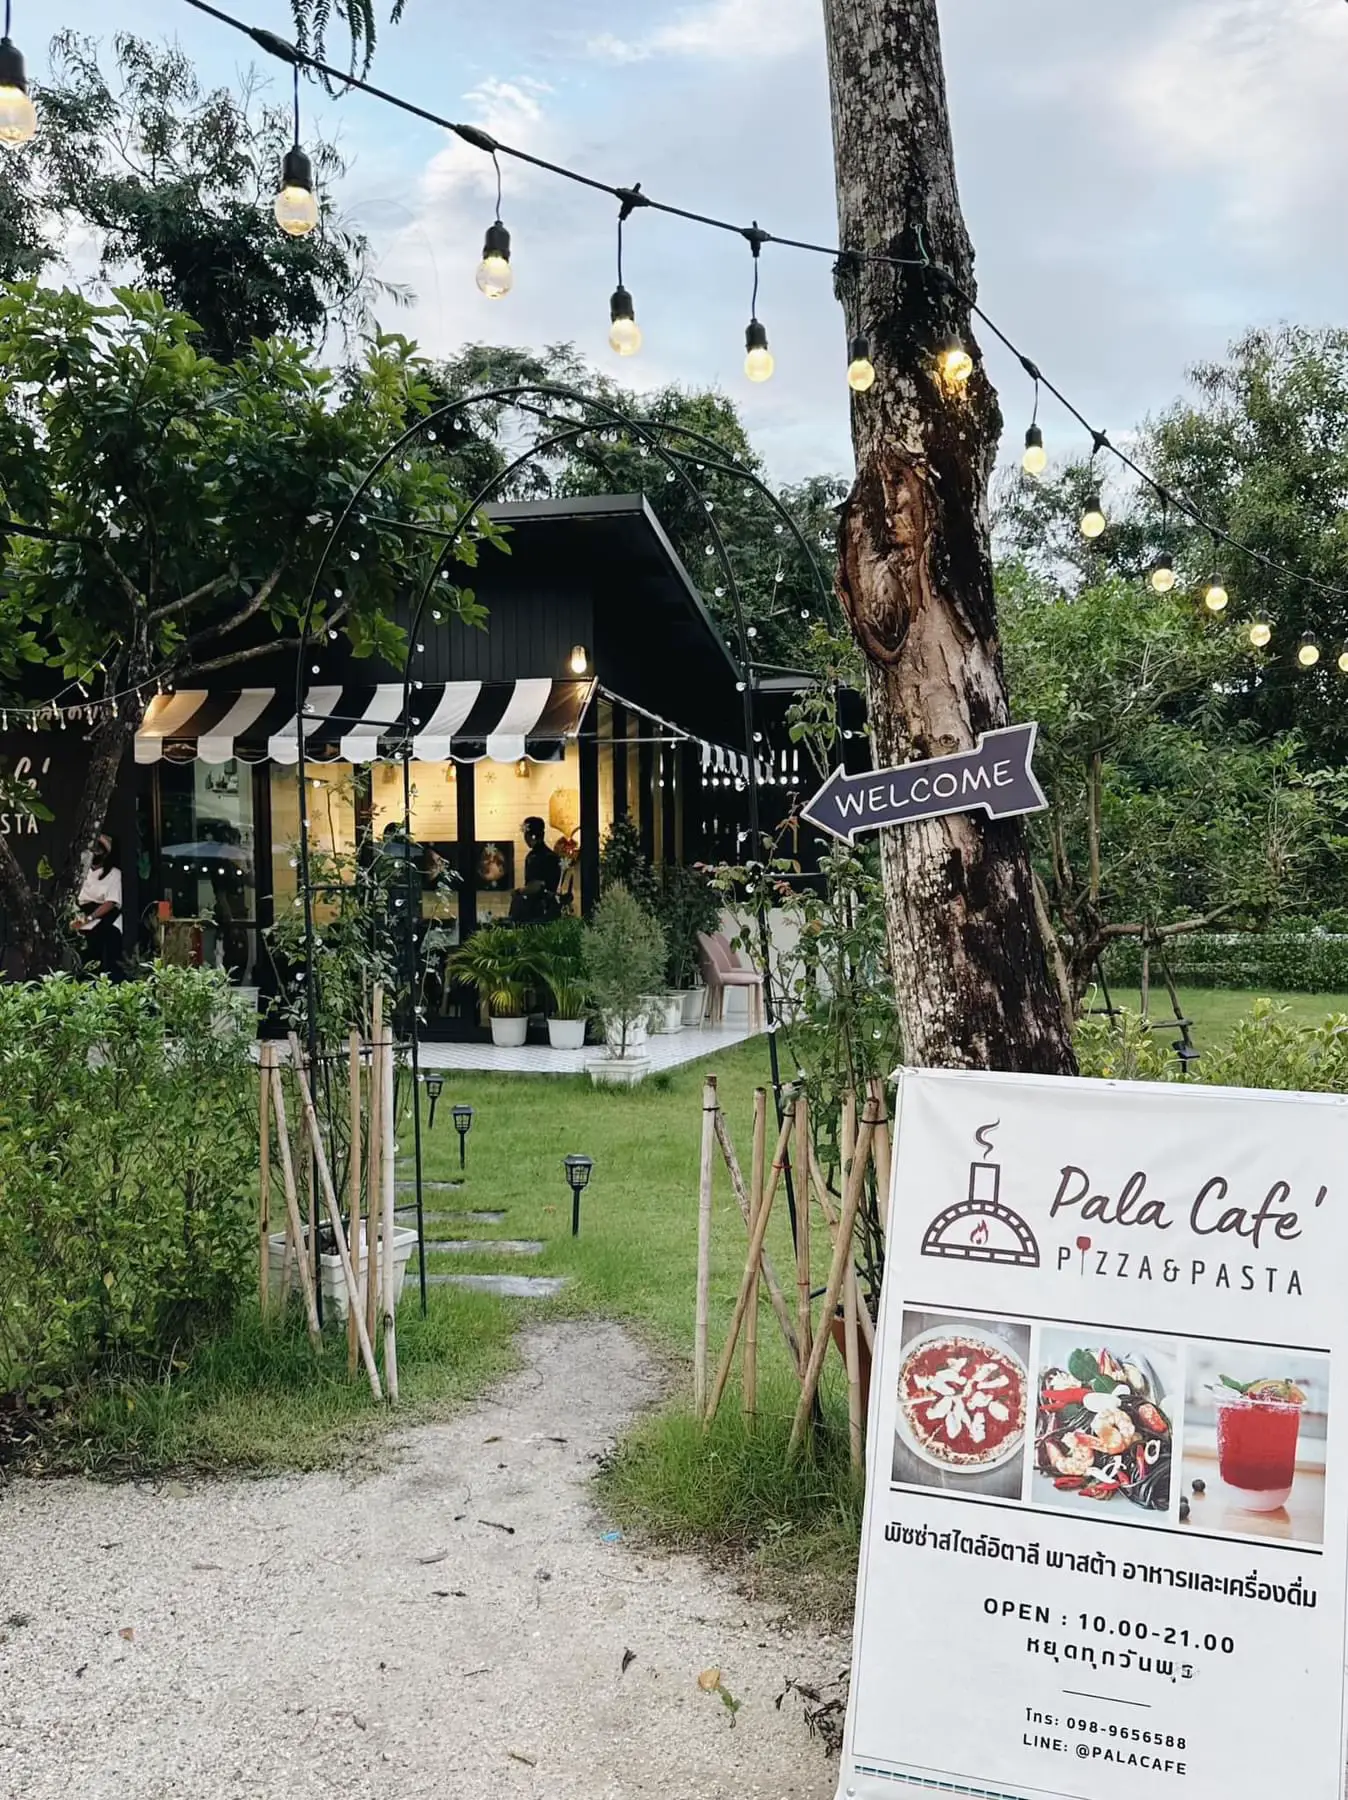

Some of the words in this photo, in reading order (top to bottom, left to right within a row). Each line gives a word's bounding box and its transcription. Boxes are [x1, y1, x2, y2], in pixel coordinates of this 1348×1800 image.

[835, 759, 1014, 818] WELCOME
[1050, 1165, 1173, 1230] Pala
[884, 1521, 1039, 1565] พิซซ่าสไตล์อิตาลี
[1046, 1549, 1116, 1577] พาสต้า
[1123, 1562, 1317, 1608] อาหารและเครื่องดื่ม
[984, 1598, 1050, 1624] OPEN
[1079, 1613, 1235, 1654] 10.00-21.00
[1023, 1733, 1068, 1752] LINE:
[1075, 1743, 1187, 1775] @PALACAFE
[1066, 1717, 1187, 1750] 098-9656588
